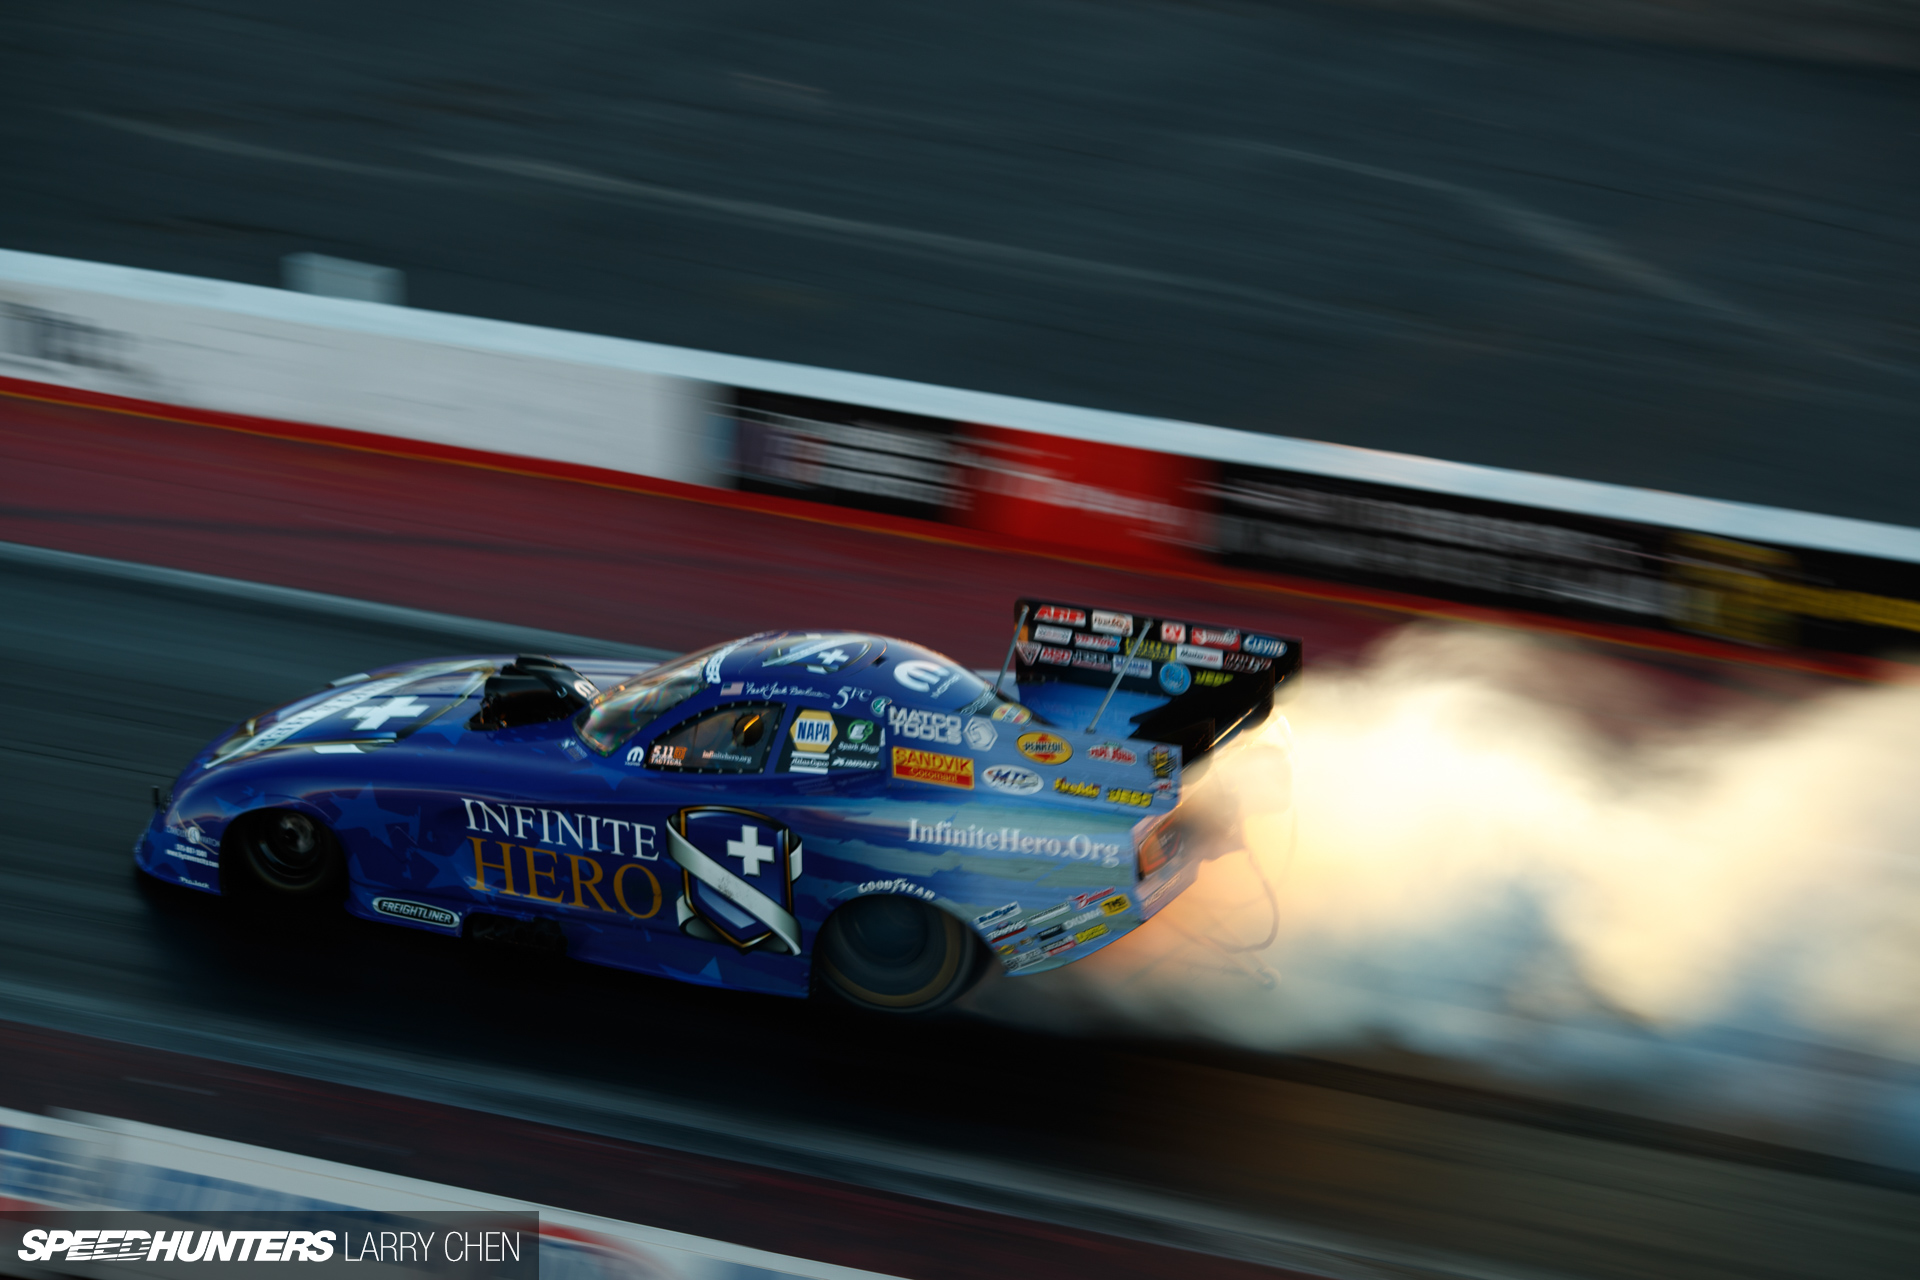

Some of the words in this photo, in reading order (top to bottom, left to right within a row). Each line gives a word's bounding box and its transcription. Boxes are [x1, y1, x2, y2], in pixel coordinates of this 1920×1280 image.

[888, 705, 962, 730] MATCO
[797, 719, 831, 743] NAPA
[893, 722, 963, 745] TOOLS
[896, 748, 972, 772] SANDVIK
[461, 798, 660, 861] INFINITE
[907, 817, 1120, 868] InfiniteHero.Org
[466, 836, 663, 919] HERO
[858, 878, 936, 900] GOODYEAR
[381, 901, 452, 923] FREIGHTLINER
